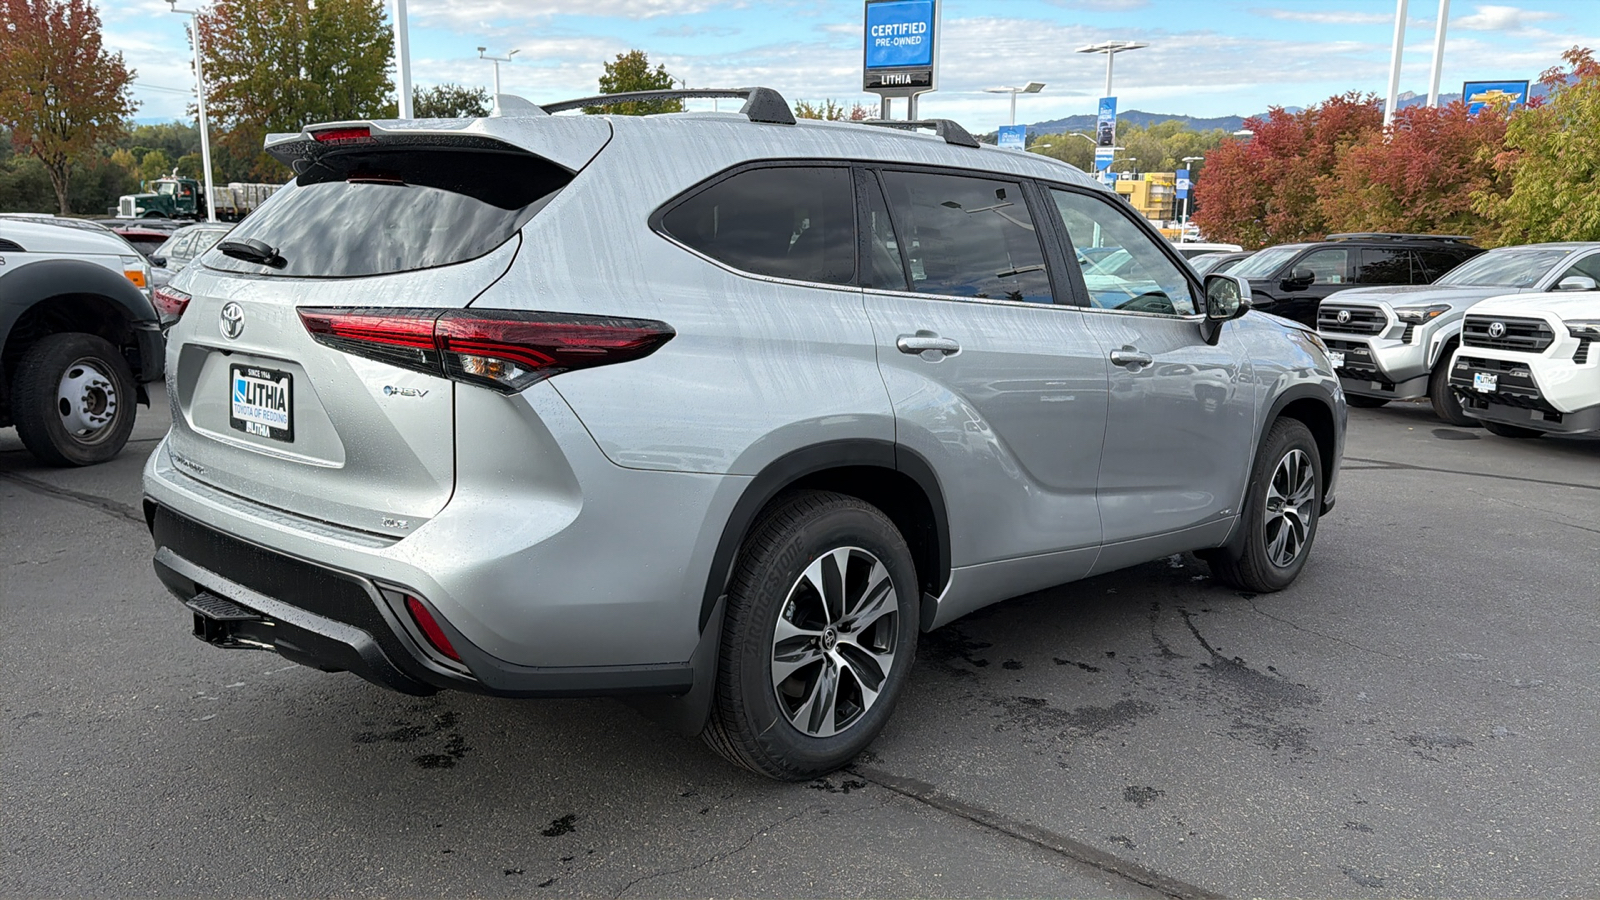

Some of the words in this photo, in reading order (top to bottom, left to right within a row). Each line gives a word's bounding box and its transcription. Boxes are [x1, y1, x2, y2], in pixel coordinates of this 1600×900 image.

[871, 22, 926, 37] CERTIFIED
[875, 36, 922, 47] PRE-OWNED
[881, 74, 911, 85] LITHIA
[248, 368, 260, 377] SINCE
[246, 381, 286, 412] LITHIA
[234, 404, 254, 416] TOYOTA
[254, 408, 262, 418] OF
[262, 409, 287, 424] REDDING
